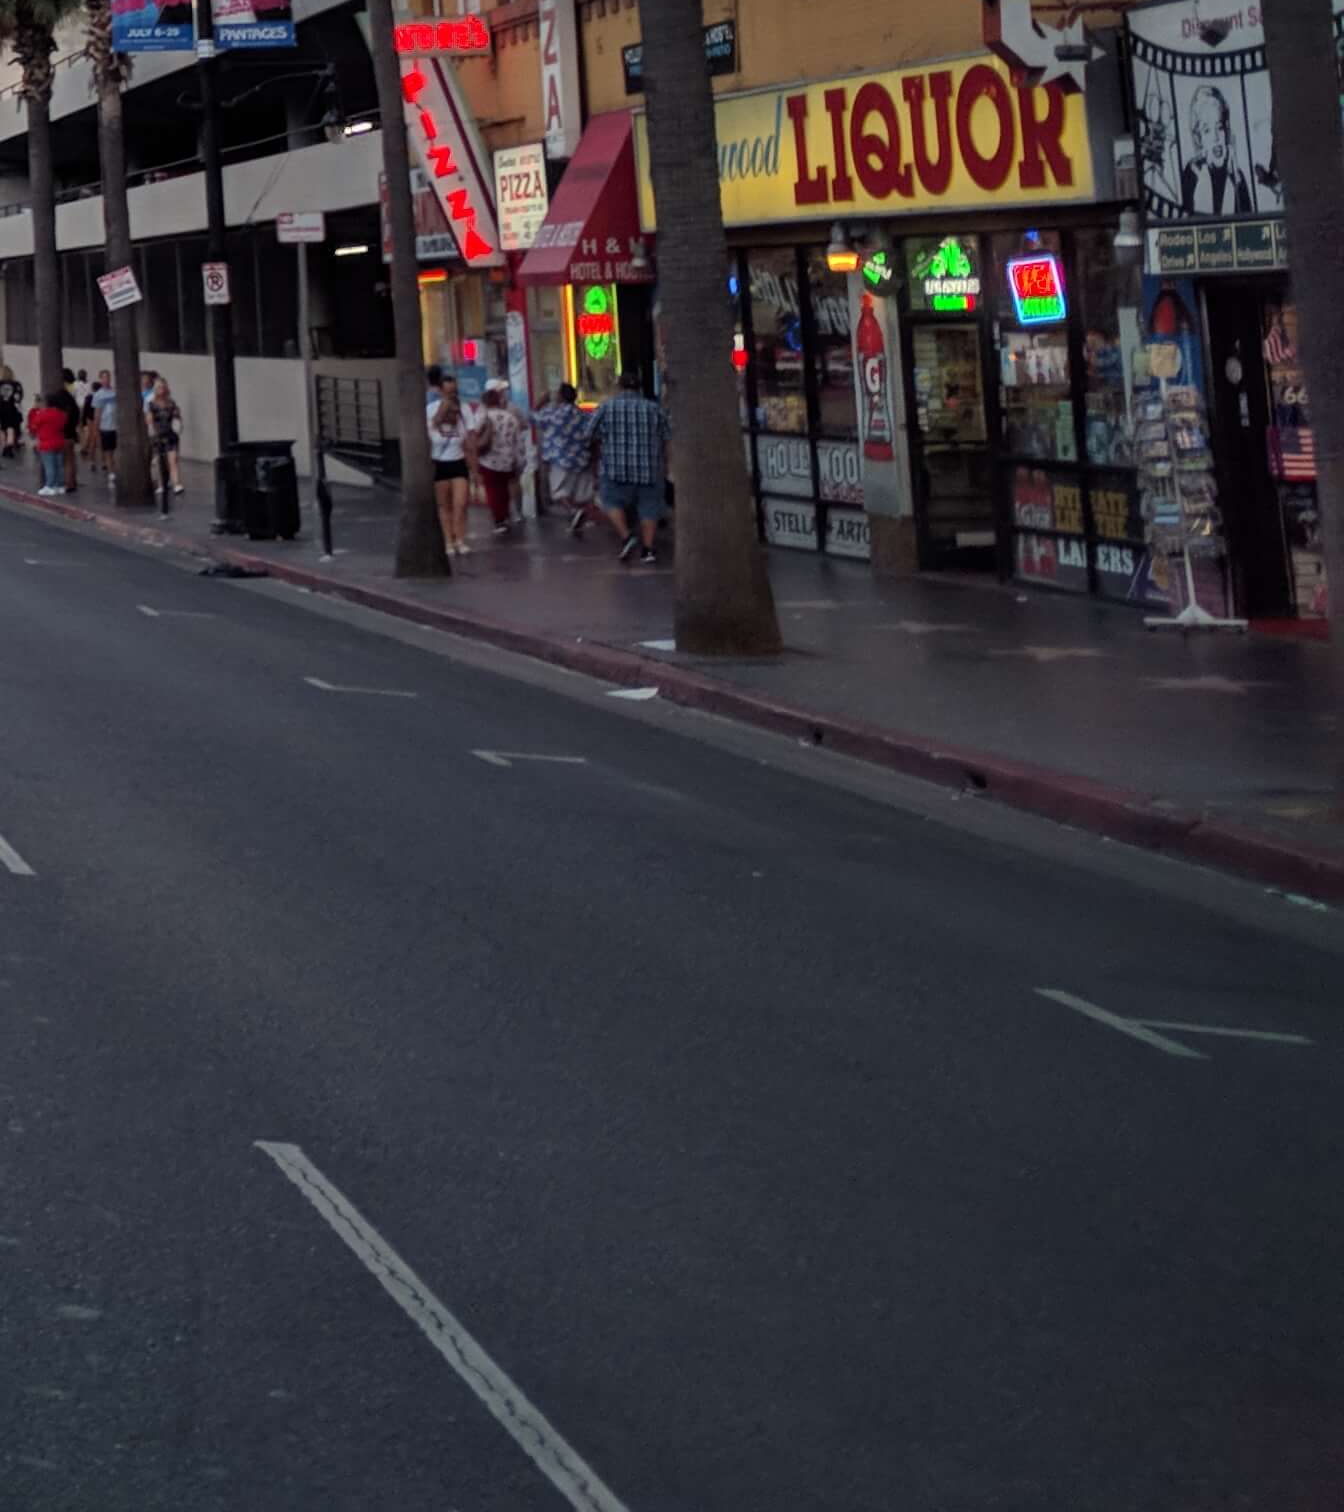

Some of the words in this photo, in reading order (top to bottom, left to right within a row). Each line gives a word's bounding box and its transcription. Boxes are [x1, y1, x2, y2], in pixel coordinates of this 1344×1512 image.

[127, 27, 151, 38] JULY
[219, 26, 287, 41] PANTAGES
[786, 61, 1074, 205] LIQUOR
[401, 72, 494, 260] PIZZA
[500, 171, 545, 202] PIZZA
[1160, 232, 1193, 246] Rodeo
[570, 262, 602, 281] HOTEL
